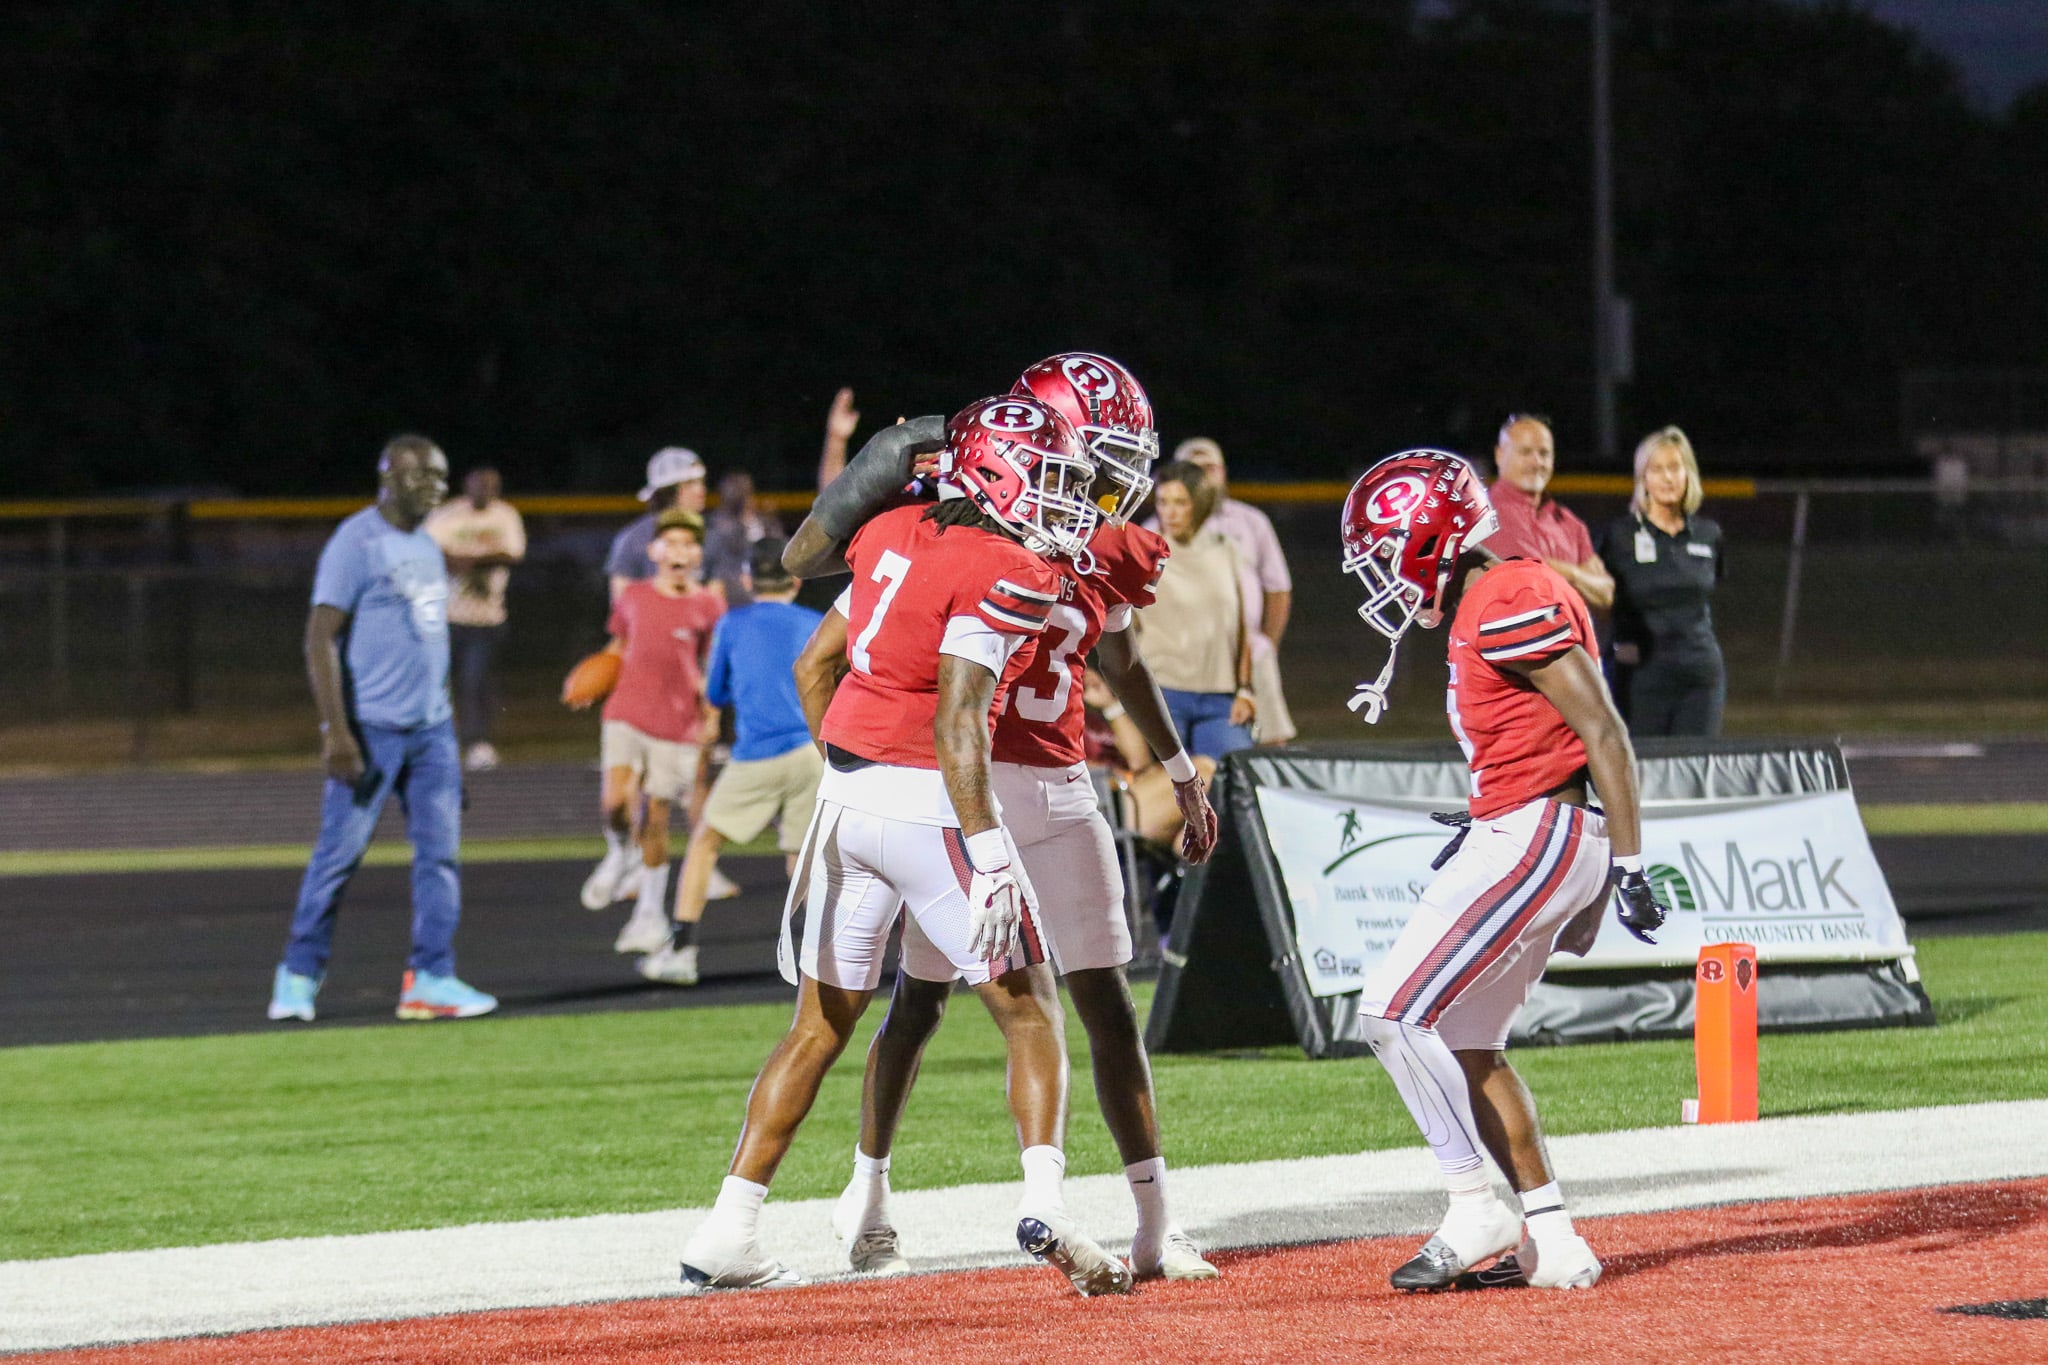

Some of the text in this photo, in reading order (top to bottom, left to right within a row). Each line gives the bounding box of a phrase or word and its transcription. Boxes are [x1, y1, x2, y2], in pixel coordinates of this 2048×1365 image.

[1067, 360, 1110, 397] R
[987, 404, 1036, 429] R
[1371, 481, 1421, 520] R
[851, 548, 912, 676] 7
[1001, 603, 1087, 722] 3
[1334, 885, 1367, 901] Bank
[1372, 885, 1405, 901] With
[1704, 922, 1870, 942] COMMUNITY BANK
[1701, 960, 1724, 981] R
